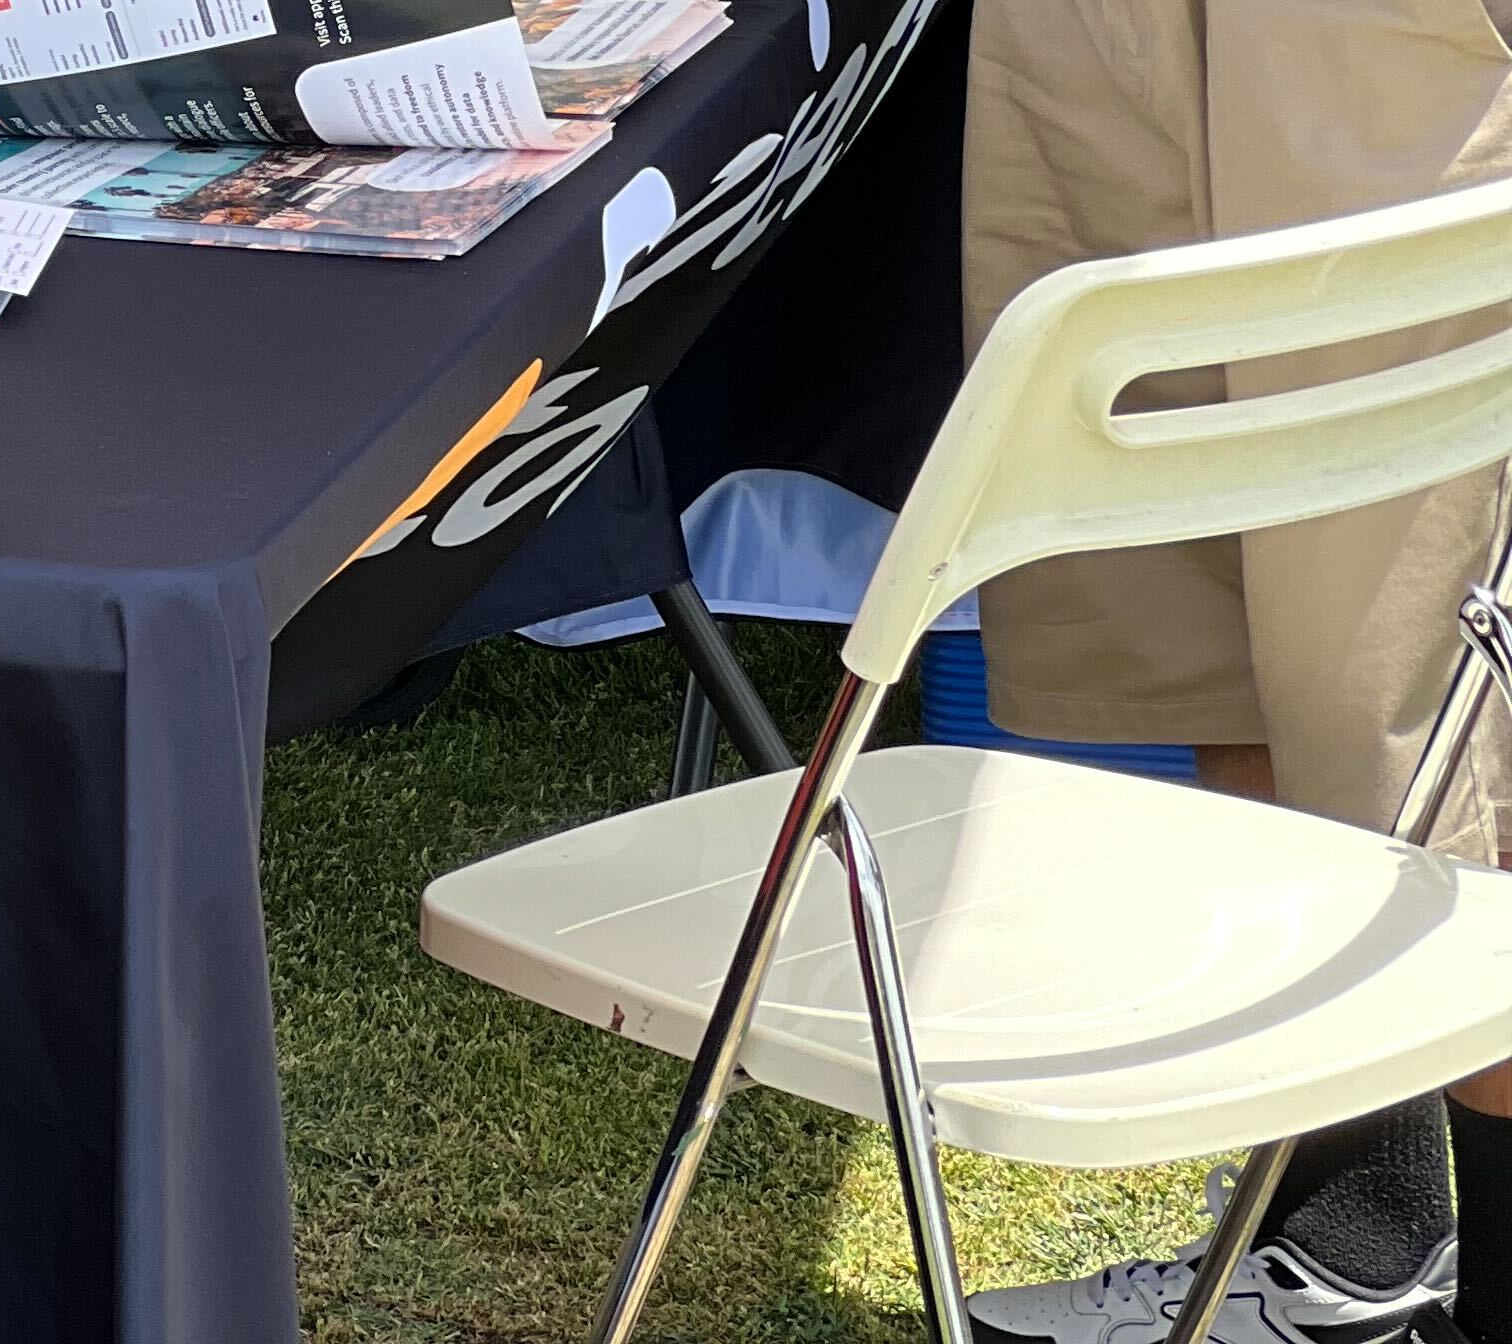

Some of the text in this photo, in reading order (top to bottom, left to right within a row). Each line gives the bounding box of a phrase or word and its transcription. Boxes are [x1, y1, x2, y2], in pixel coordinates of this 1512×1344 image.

[313, 20, 332, 47] Visit
[332, 14, 352, 45] Scan
[242, 86, 258, 101] for
[401, 75, 418, 114] freedom
[434, 63, 458, 113] autonomy
[463, 93, 476, 113] data
[474, 71, 497, 121] knowledge
